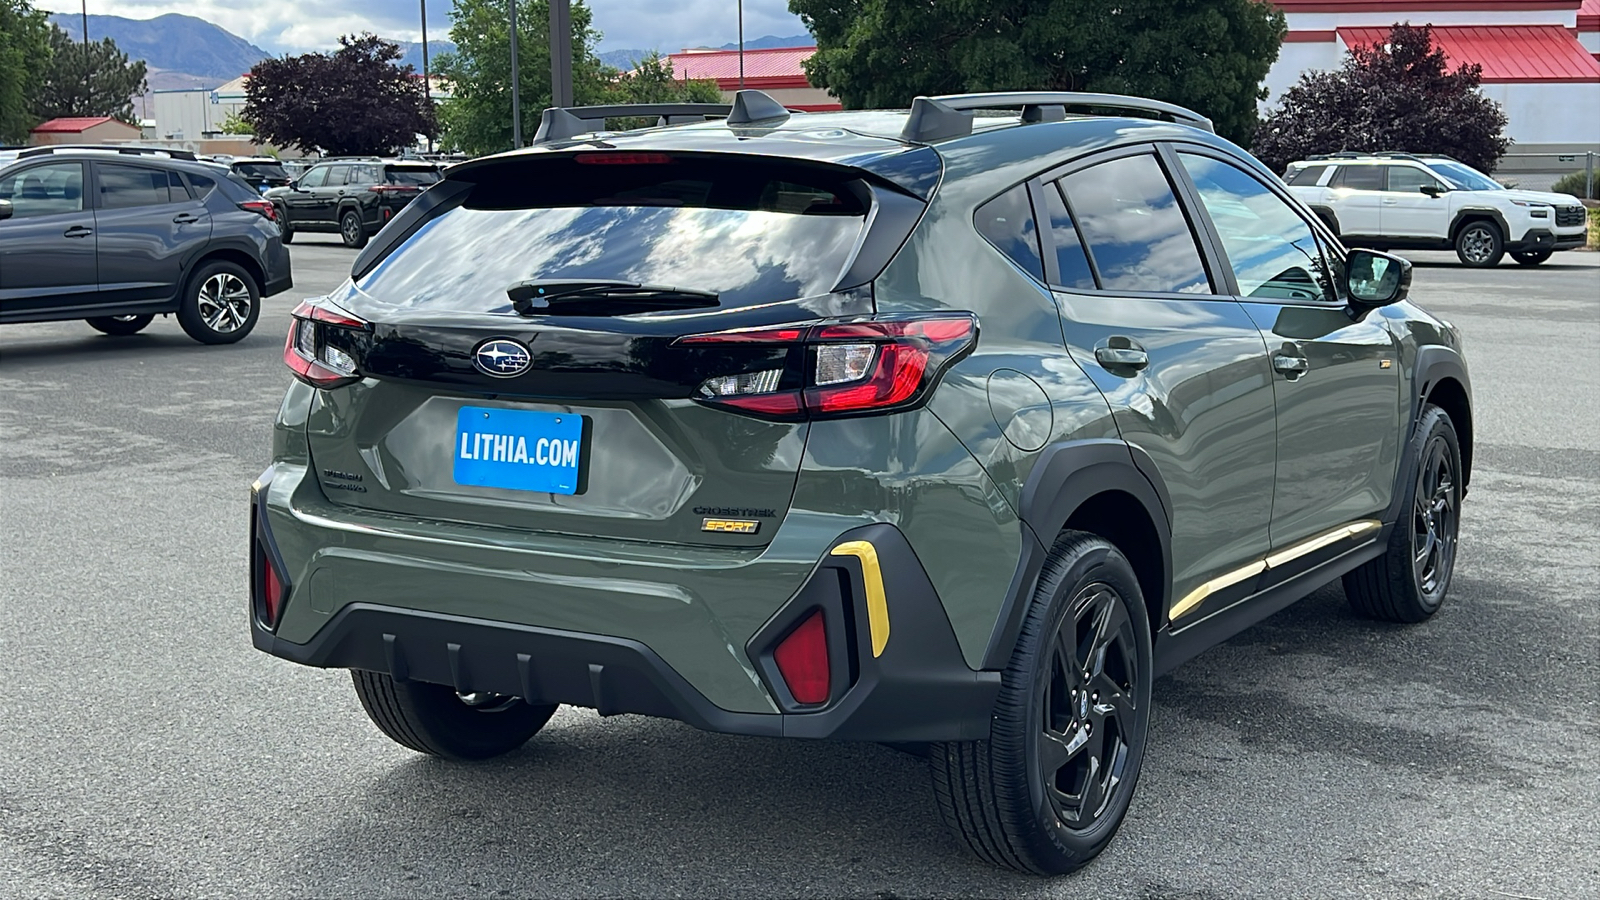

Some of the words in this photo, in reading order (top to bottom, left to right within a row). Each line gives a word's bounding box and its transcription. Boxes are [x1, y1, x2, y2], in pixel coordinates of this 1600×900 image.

[460, 432, 578, 468] LITHIA.COM
[692, 506, 777, 518] CROSSTREK
[705, 521, 754, 532] SPORT
